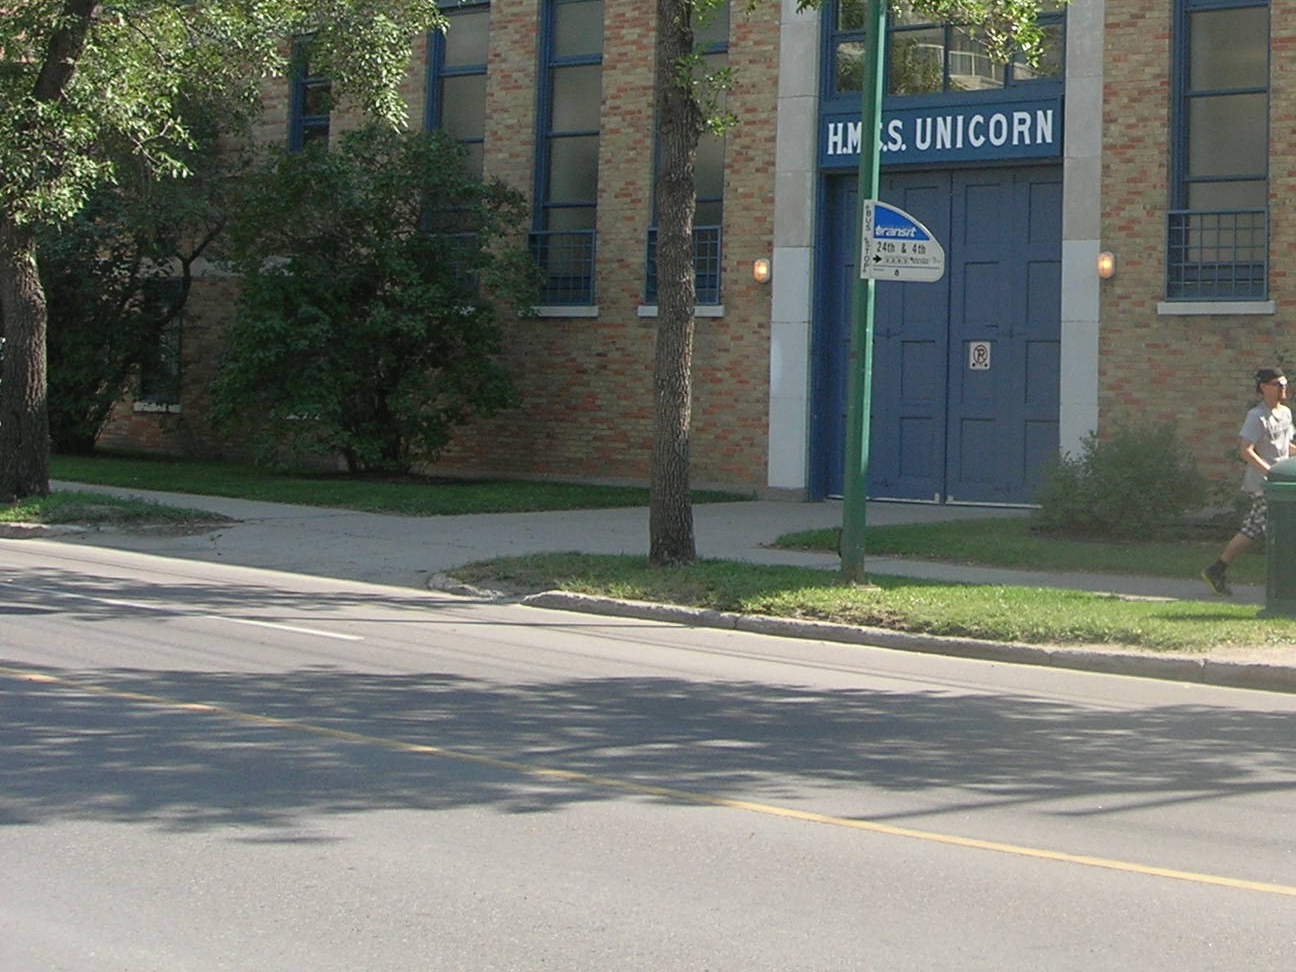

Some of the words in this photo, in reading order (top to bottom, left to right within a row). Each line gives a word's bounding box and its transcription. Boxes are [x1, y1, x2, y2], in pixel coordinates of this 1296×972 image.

[915, 110, 1053, 150] UNICORN
[876, 224, 917, 237] transit
[876, 241, 895, 253] 24th
[912, 243, 926, 255] 4th
